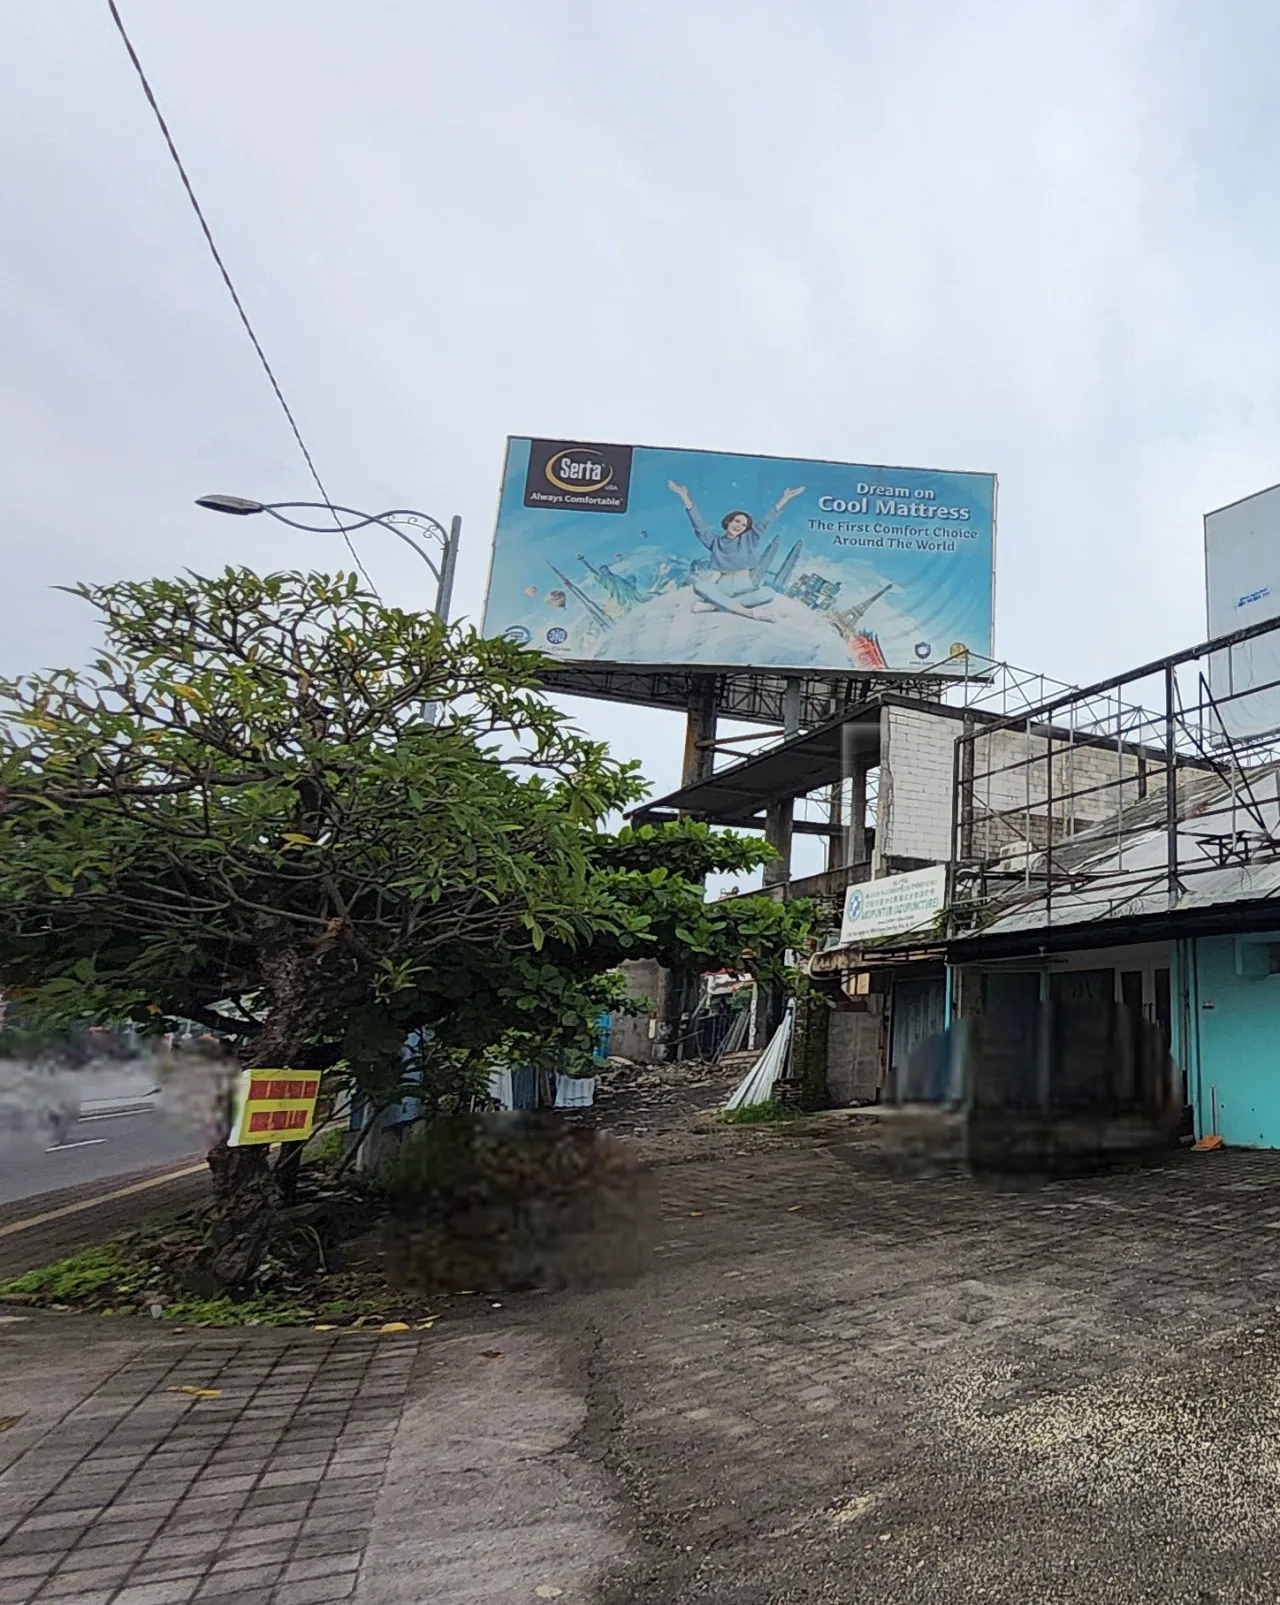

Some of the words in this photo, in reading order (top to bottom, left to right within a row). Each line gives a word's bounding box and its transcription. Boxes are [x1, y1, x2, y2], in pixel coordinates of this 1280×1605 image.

[560, 458, 601, 480] Serta
[530, 492, 563, 502] Always
[564, 494, 621, 506] Comfortable
[856, 482, 910, 499] Dream
[914, 487, 935, 500] on
[818, 495, 868, 514] Cool
[876, 499, 971, 521] Mattress
[808, 519, 834, 531] The
[837, 521, 869, 533] First
[873, 523, 929, 538] Comfort
[933, 527, 978, 540] Choice
[833, 535, 884, 548] Around
[888, 537, 912, 549] The
[916, 539, 956, 552] World
